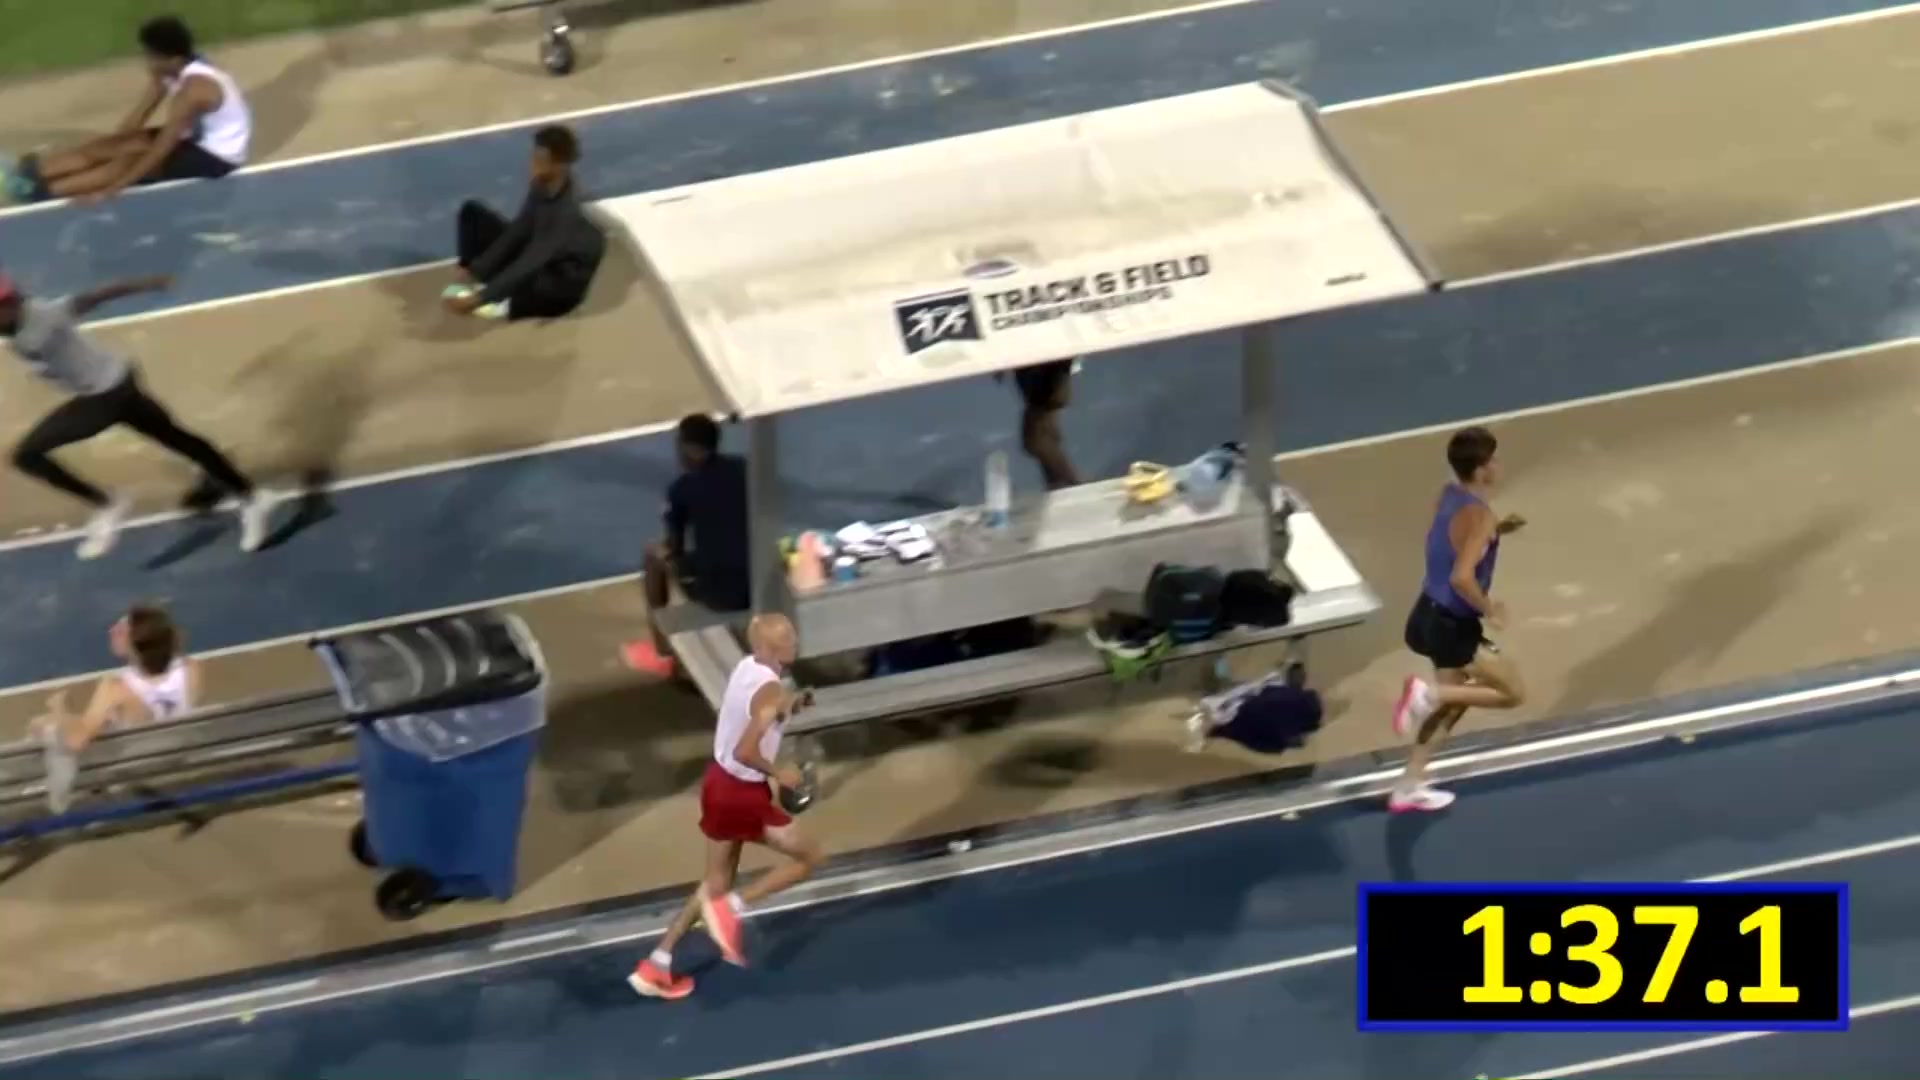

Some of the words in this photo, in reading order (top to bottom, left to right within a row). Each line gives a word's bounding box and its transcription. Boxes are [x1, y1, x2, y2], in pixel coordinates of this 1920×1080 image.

[984, 276, 1089, 315] TRACK
[1093, 271, 1118, 295] &
[1122, 253, 1210, 289] FIELD
